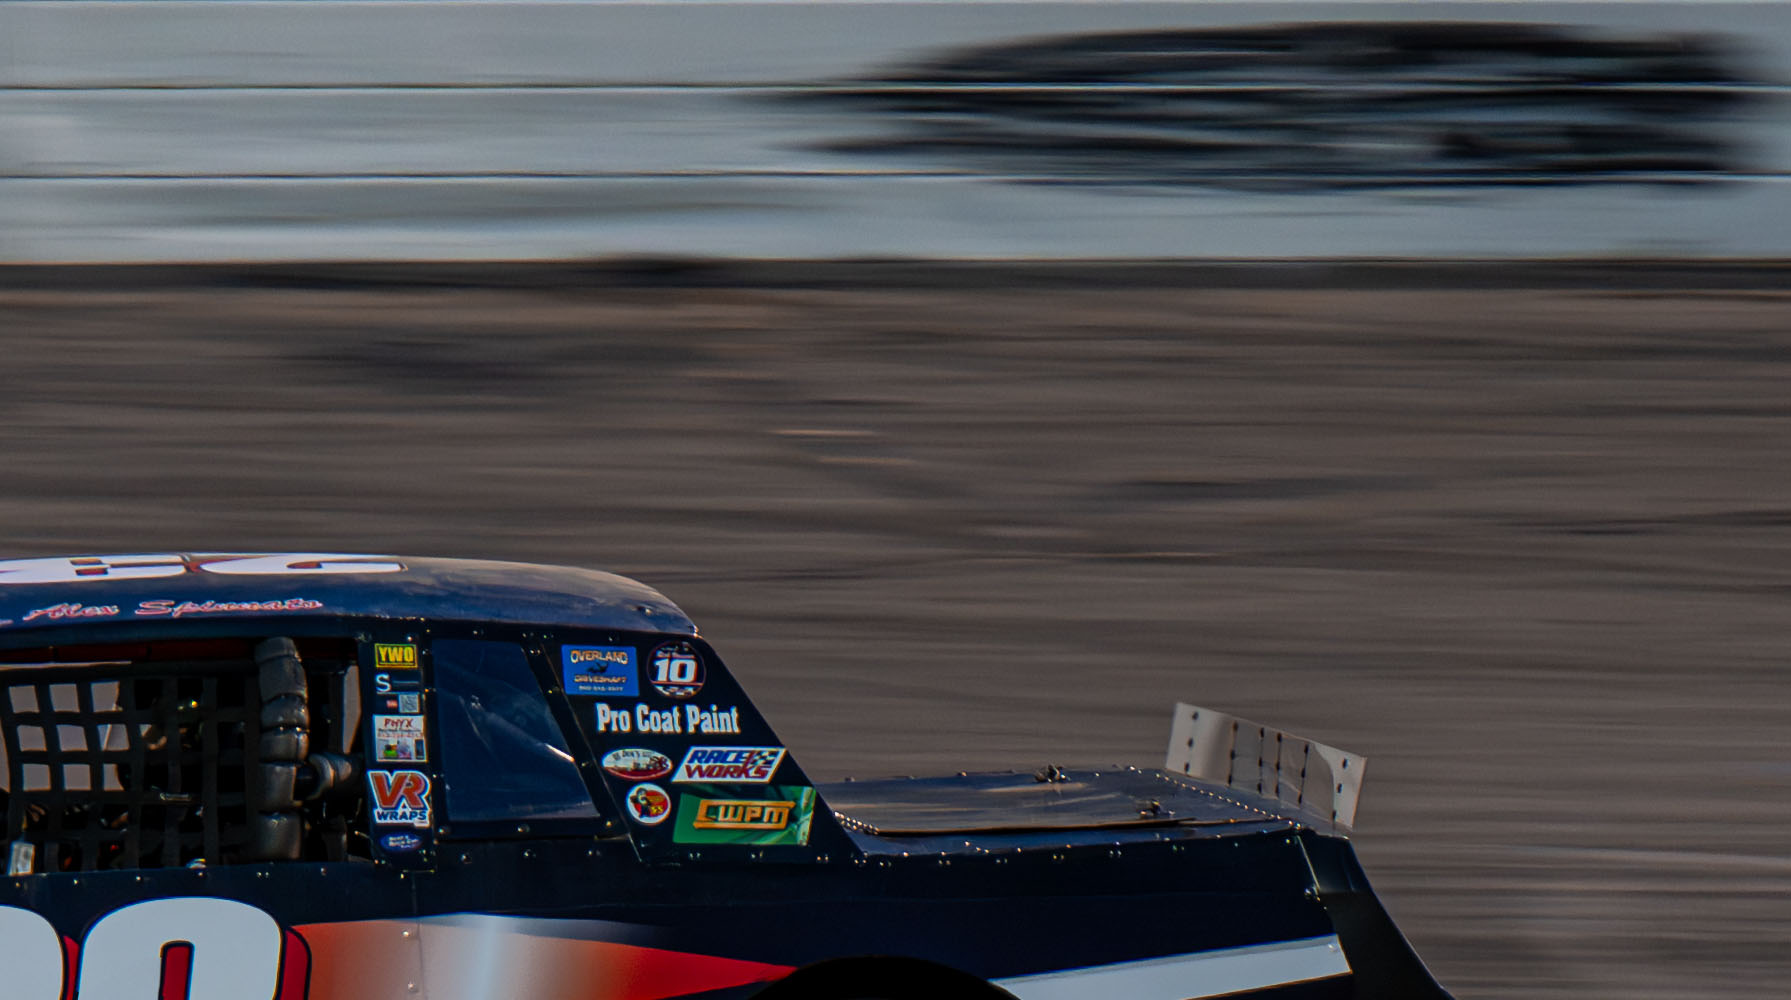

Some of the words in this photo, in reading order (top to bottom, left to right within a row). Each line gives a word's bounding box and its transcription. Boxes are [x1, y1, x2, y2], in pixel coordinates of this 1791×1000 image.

[22, 603, 119, 620] Alex
[570, 649, 629, 664] OVERLAND
[653, 657, 698, 683] 10
[375, 673, 392, 692] S
[595, 702, 631, 732] Pro
[636, 702, 682, 733] Coat
[685, 703, 741, 733] Paint
[689, 750, 749, 764] RACE
[685, 764, 770, 779] WORKS
[369, 771, 428, 808] VR
[377, 809, 427, 821] WRAPS
